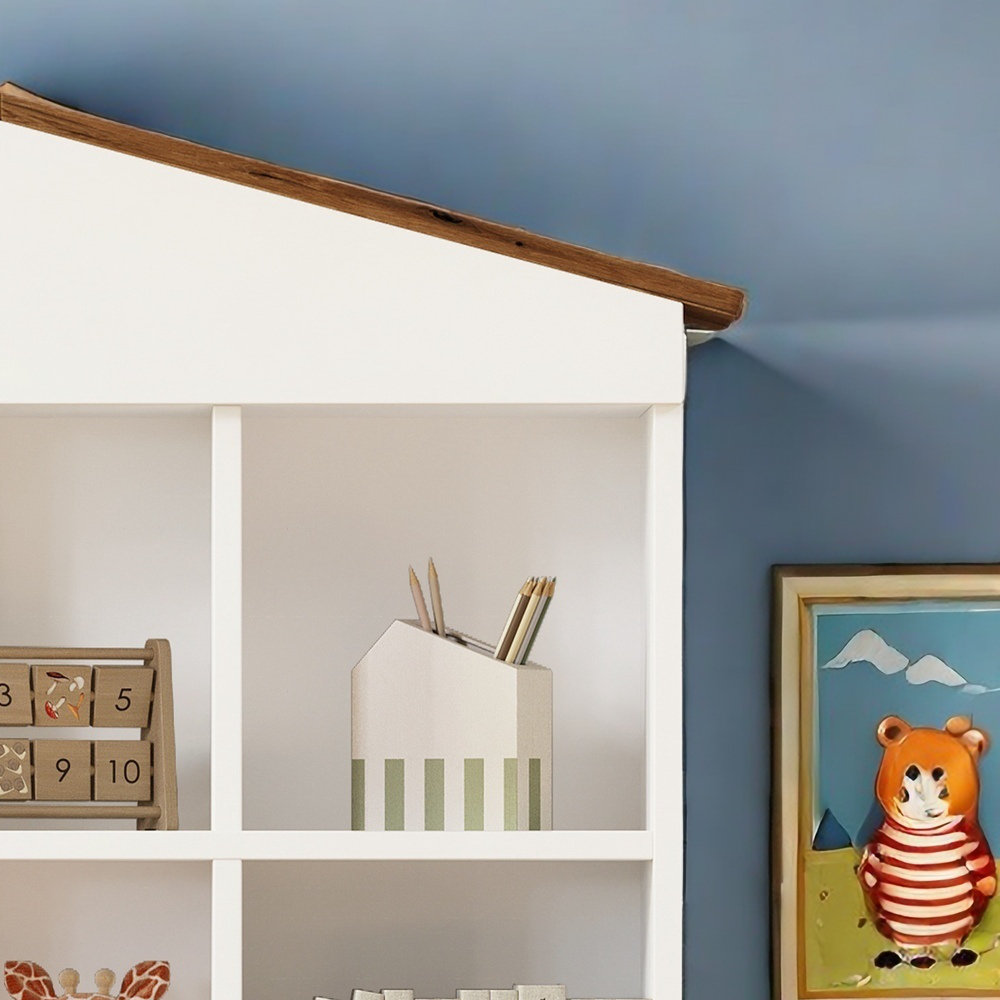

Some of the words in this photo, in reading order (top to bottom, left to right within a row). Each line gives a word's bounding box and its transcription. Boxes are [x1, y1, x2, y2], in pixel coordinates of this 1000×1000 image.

[114, 687, 133, 712] 5
[55, 757, 71, 783] 9
[109, 759, 141, 785] 10
